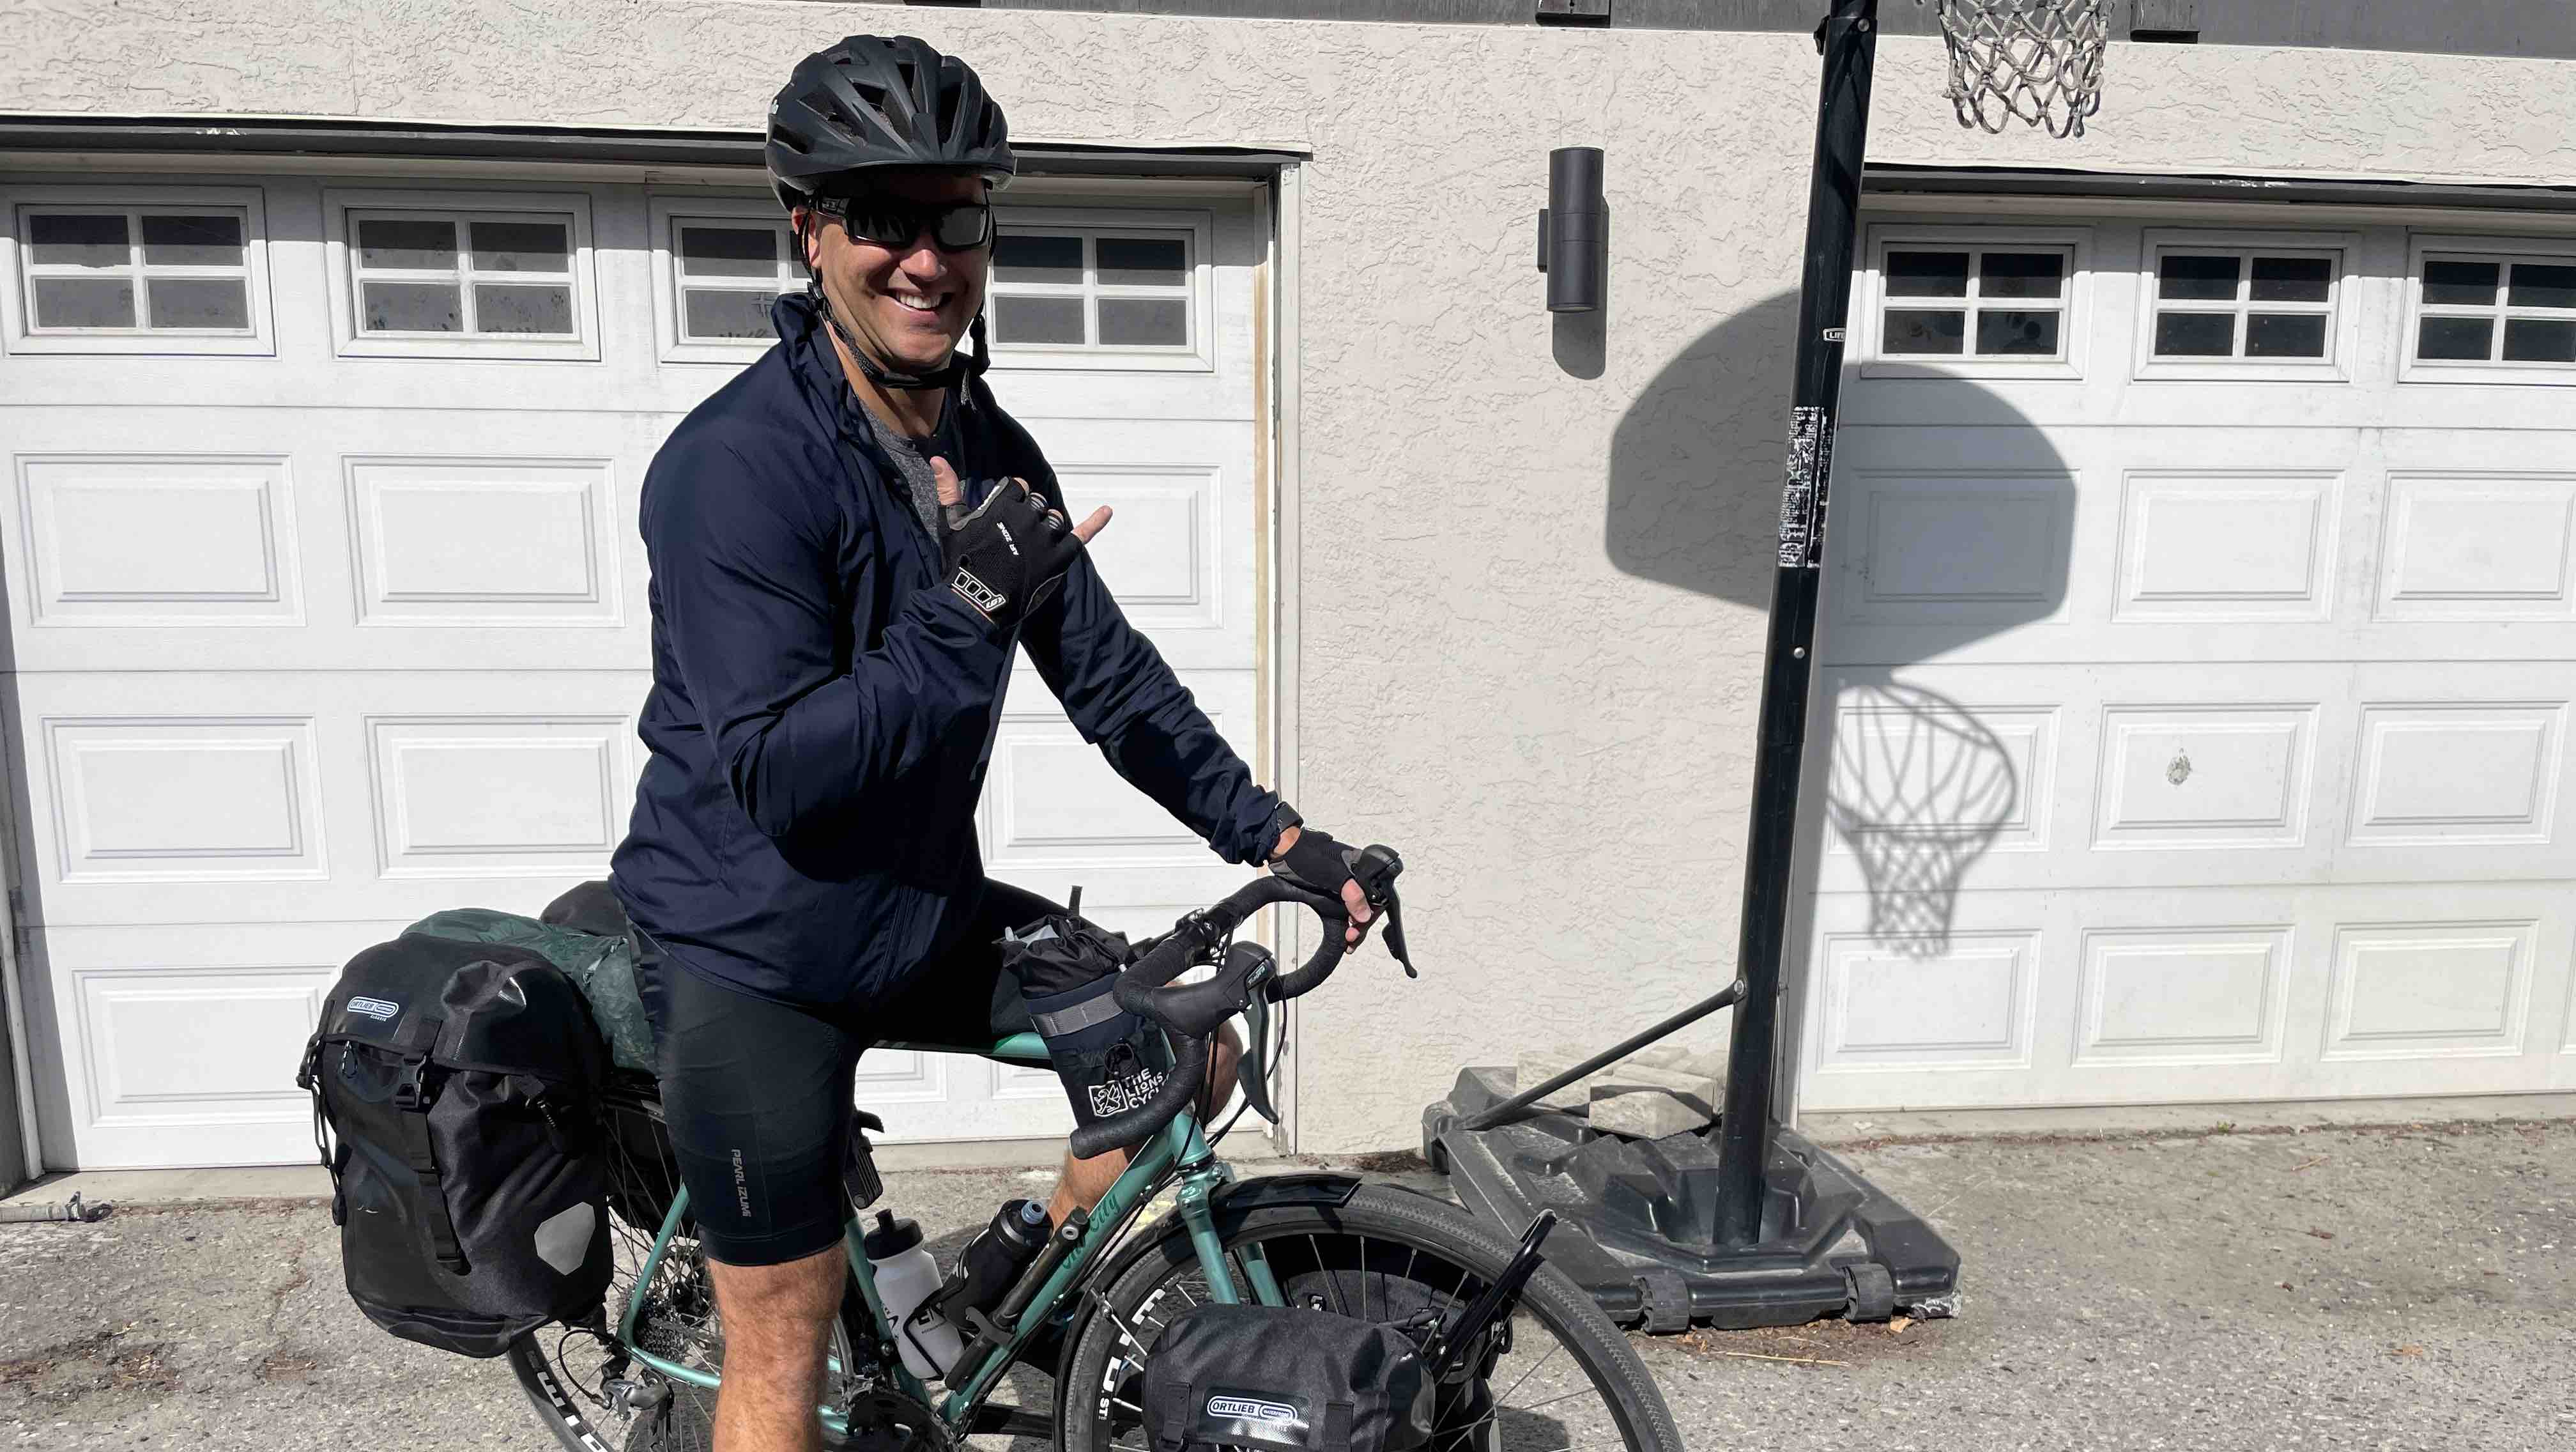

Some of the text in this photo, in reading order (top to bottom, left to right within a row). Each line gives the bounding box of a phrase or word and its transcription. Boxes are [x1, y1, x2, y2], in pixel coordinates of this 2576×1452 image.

[1122, 1067, 1152, 1088] THE
[1125, 1072, 1163, 1100] LIONS
[731, 1148, 746, 1186] PEARL
[1213, 1401, 1256, 1414] ORTLIEB
